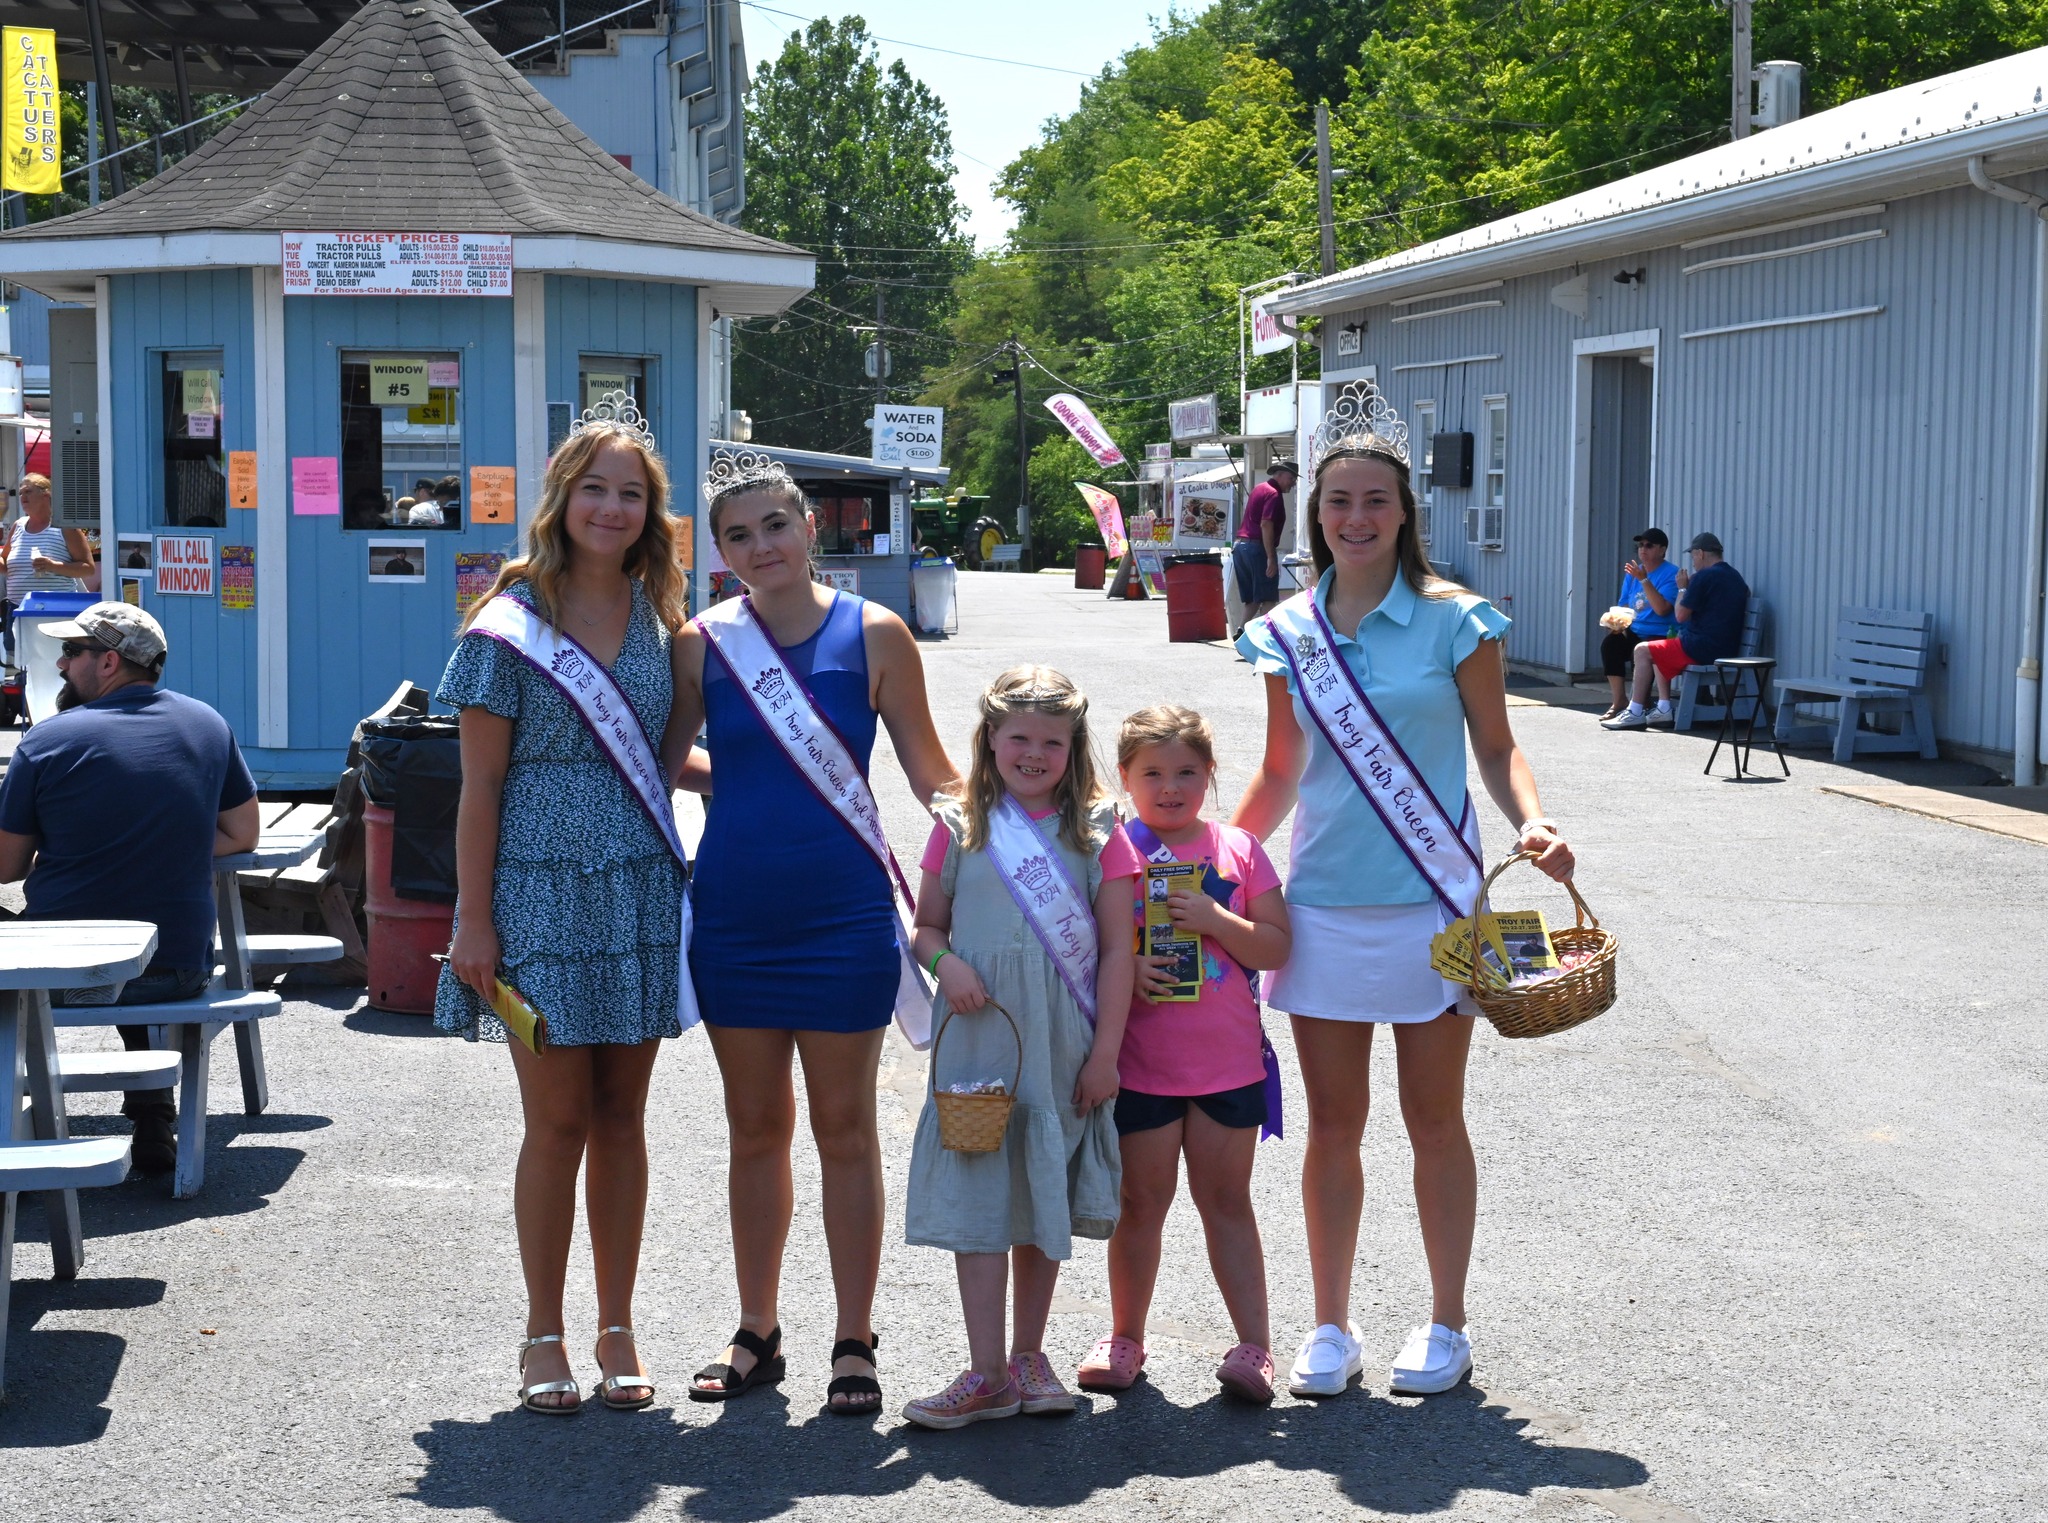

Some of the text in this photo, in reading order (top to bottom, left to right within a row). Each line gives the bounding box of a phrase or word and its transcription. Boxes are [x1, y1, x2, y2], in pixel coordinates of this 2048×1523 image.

[20, 36, 38, 142] CACTUS
[36, 56, 56, 163] TATERS
[335, 234, 460, 243] TICKET PRICES
[1340, 334, 1358, 351] OFFICE
[374, 366, 424, 374] WINDOW
[188, 379, 200, 387] Will
[388, 384, 410, 396] #5
[590, 380, 623, 388] WINDOW
[884, 412, 935, 424] WATER
[1053, 400, 1080, 428] COOKIE
[896, 432, 936, 443] SODA
[1076, 426, 1102, 452] DOUGH
[477, 473, 509, 481] Earplugs
[1179, 485, 1186, 494] at
[1188, 482, 1208, 493] Cookie
[161, 540, 208, 564] WILL CALL
[159, 567, 211, 592] WINDOW
[574, 670, 596, 694] 2024
[1315, 673, 1339, 698] 2024
[769, 690, 793, 713] 2024
[592, 688, 611, 723] Troy
[611, 716, 629, 747] Fair
[627, 743, 650, 786] Queen
[786, 708, 804, 742] Troy
[804, 734, 823, 764] Fair
[822, 759, 847, 798] Queen
[848, 791, 868, 818] 2nd
[1334, 696, 1436, 853] Troy Fair Queen
[1033, 883, 1061, 909] 2024
[1056, 906, 1081, 958] Troy
